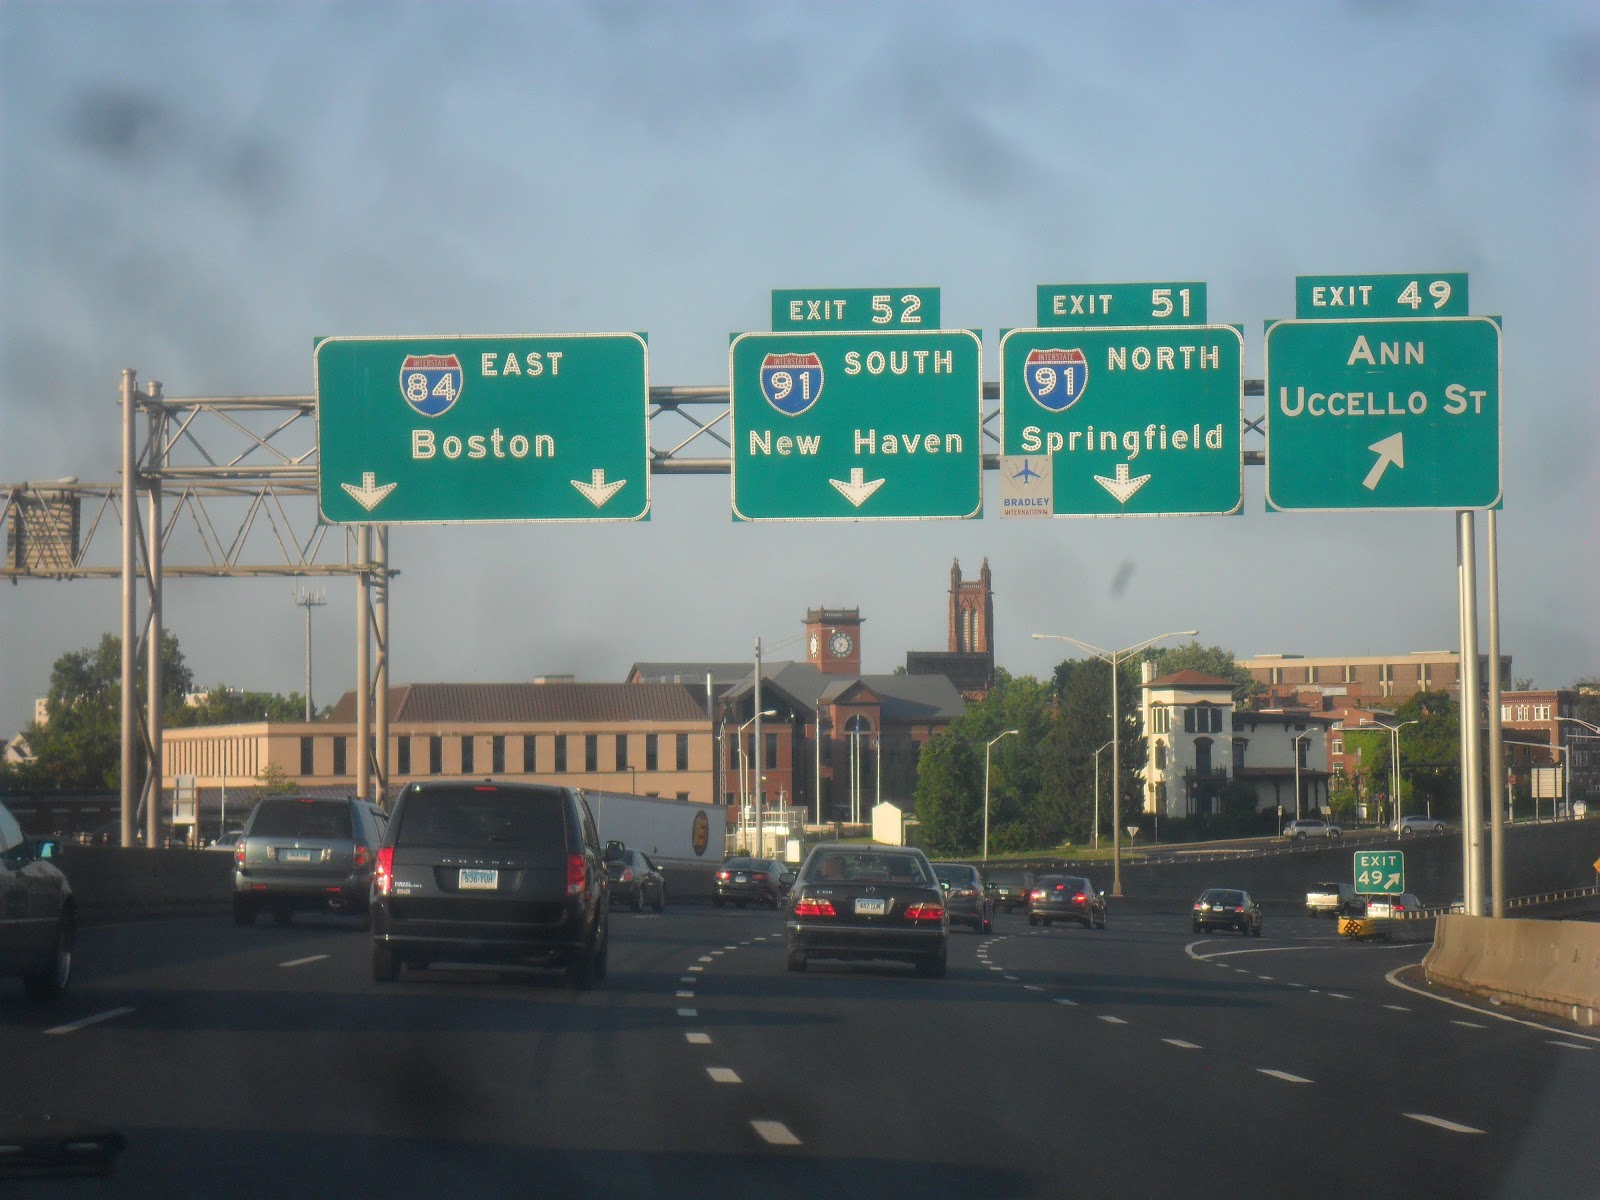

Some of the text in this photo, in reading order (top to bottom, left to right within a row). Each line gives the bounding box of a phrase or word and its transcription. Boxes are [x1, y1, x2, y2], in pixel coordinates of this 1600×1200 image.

[790, 294, 922, 324] EXIT 52
[1053, 288, 1190, 317] EXIT 51
[1313, 280, 1452, 310] EXIT 49
[413, 359, 449, 368] INTERSTATE
[481, 352, 563, 376] EAST
[773, 357, 810, 366] INTERSTATE
[844, 350, 953, 375] SOUTH
[1038, 352, 1074, 361] INTERSTATE
[1108, 346, 1219, 371] NORTH
[1346, 335, 1424, 365] ANN
[407, 373, 456, 401] 84
[771, 371, 810, 400] 91
[1035, 367, 1074, 396] 91
[1280, 384, 1487, 417] UCCELLO ST
[411, 427, 555, 459] Boston
[749, 428, 963, 456] New Haven
[1021, 424, 1223, 461] Springfield
[1004, 498, 1050, 507] BRADLEY
[1361, 856, 1397, 867] EXIT
[1358, 870, 1383, 885] 49
